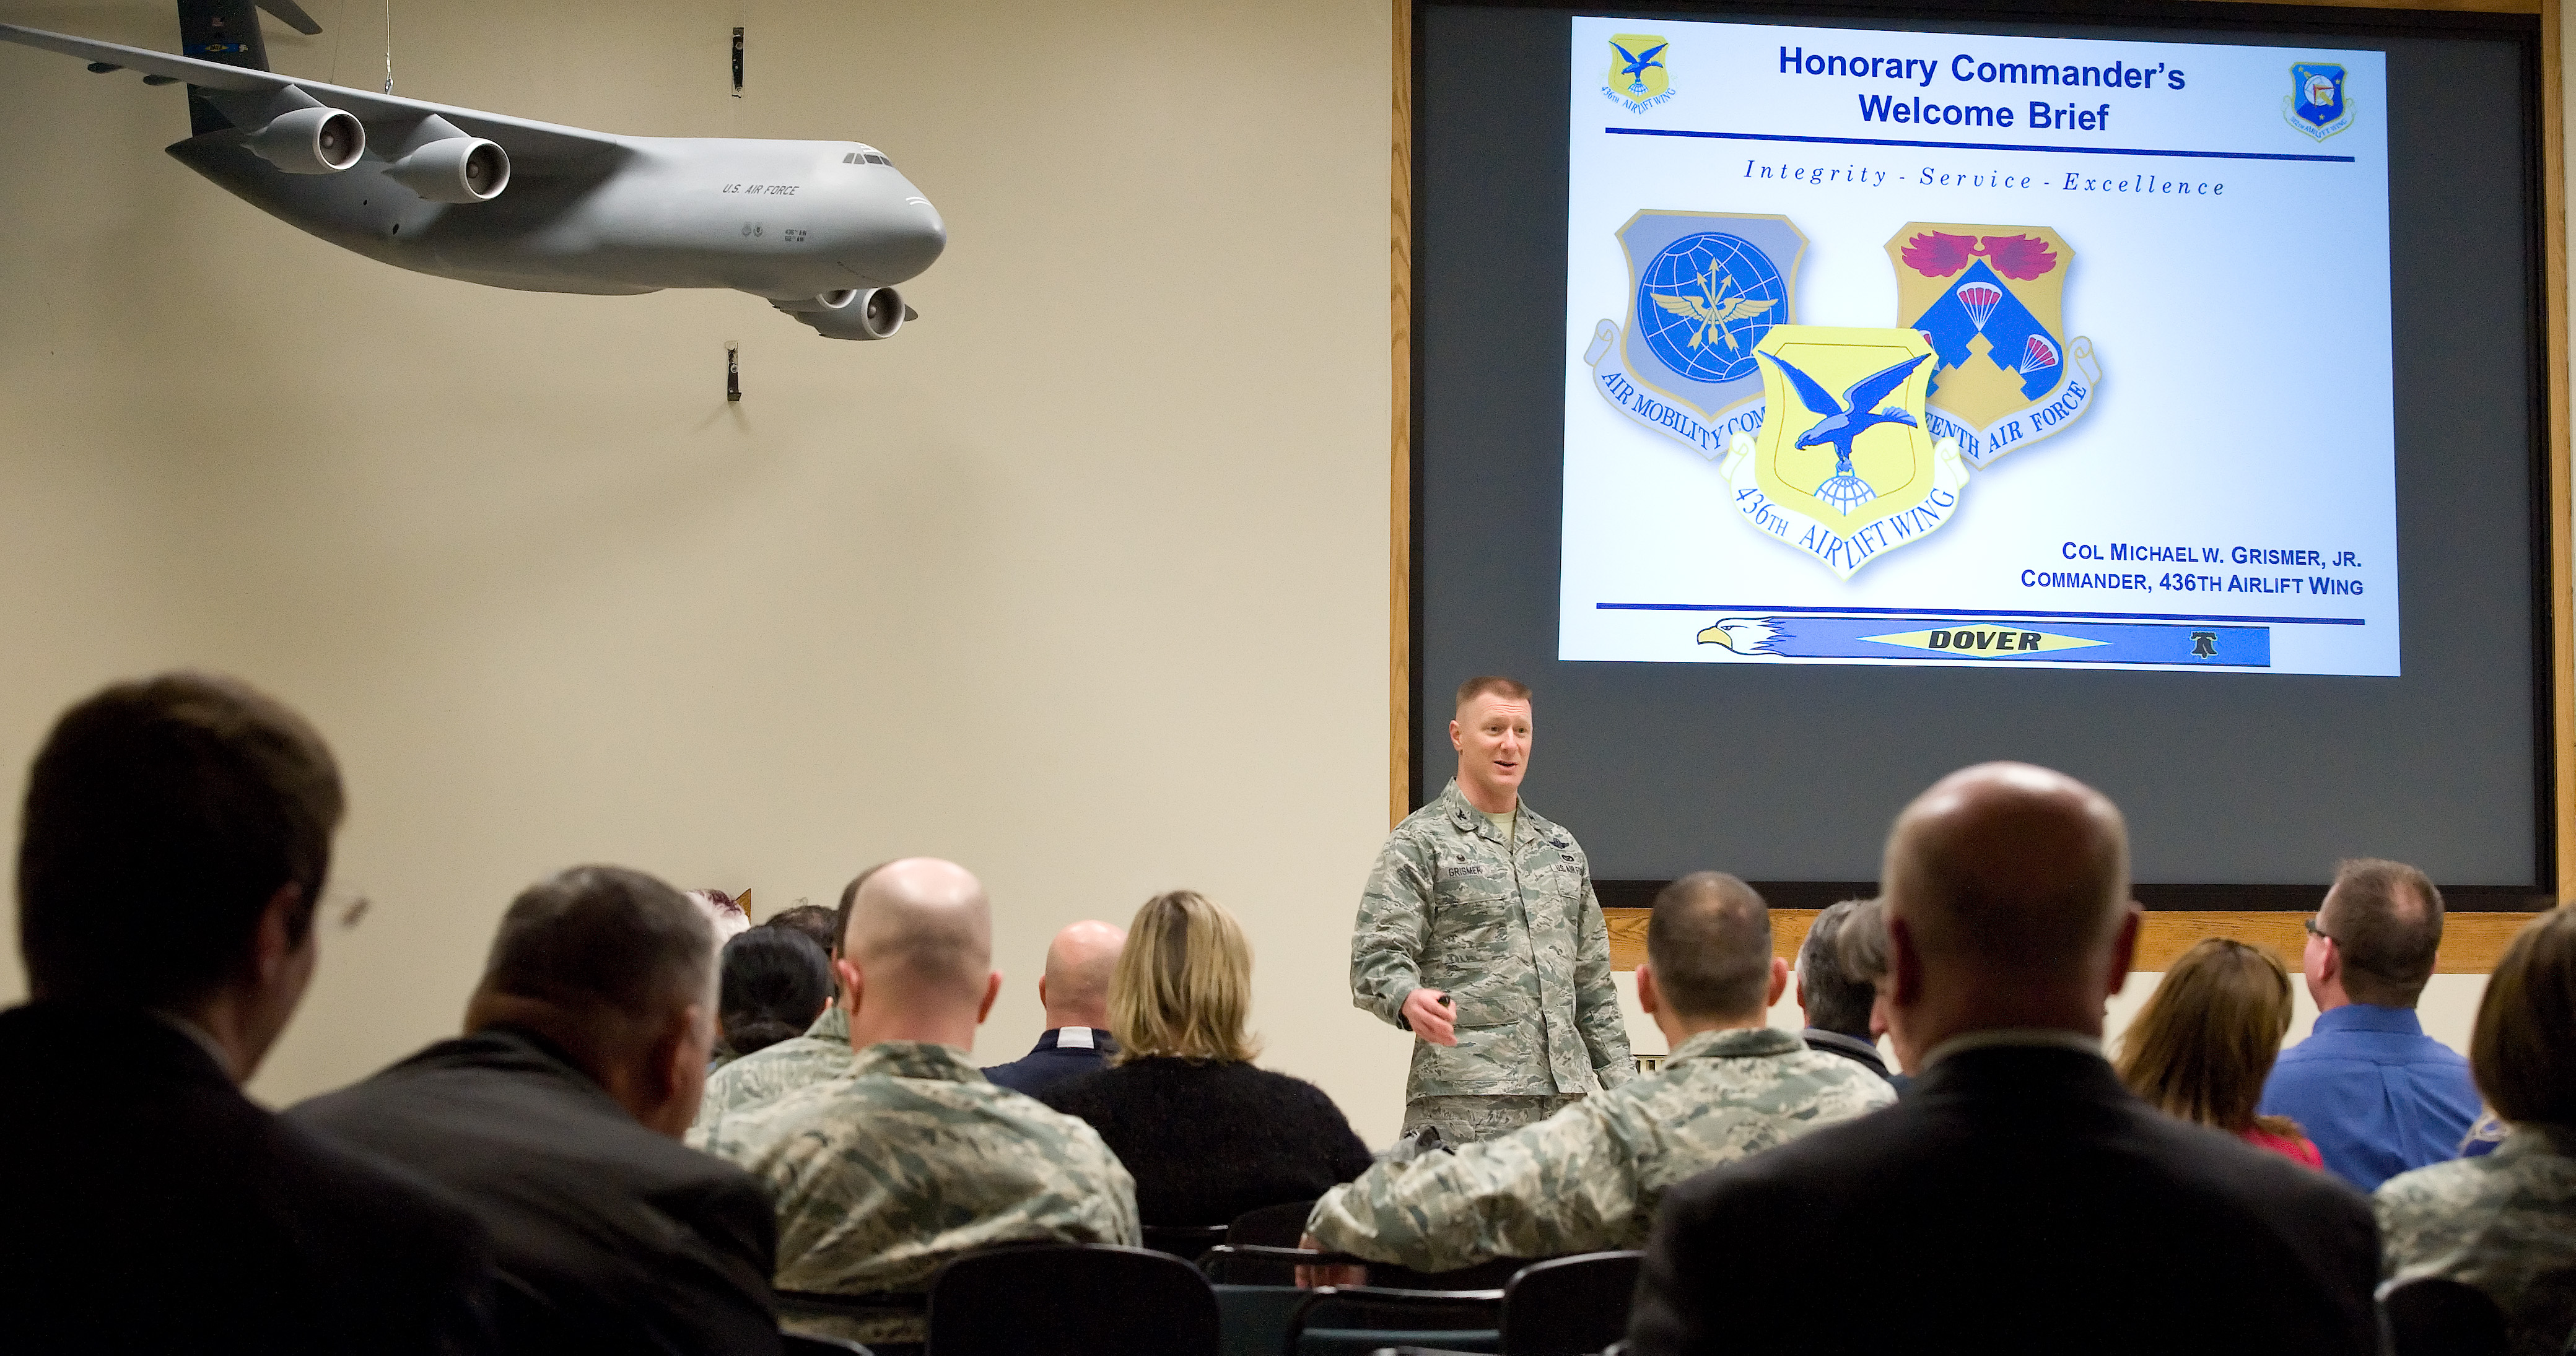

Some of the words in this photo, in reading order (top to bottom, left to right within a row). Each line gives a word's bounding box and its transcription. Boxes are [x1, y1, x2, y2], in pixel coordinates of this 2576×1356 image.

[1779, 46, 1937, 87] Honorary
[1952, 54, 2186, 90] Commander’s
[1601, 86, 1620, 103] 436TH
[1622, 98, 1653, 115] AIRLIFT
[1653, 87, 1676, 105] WING
[1858, 94, 2015, 128] Welcome
[2028, 101, 2110, 131] Brief
[723, 184, 741, 193] U.S.
[744, 185, 764, 194] AIR
[763, 185, 800, 196] FORCE
[1744, 160, 1886, 187] Integrity
[1919, 167, 2030, 188] Service
[2063, 172, 2224, 196] Excellence
[1601, 373, 1635, 406] AIR
[1631, 393, 1724, 450] MOBILITY
[1989, 420, 2023, 454] AIR
[2029, 380, 2087, 432] FORCE
[1736, 488, 1789, 537] 436TH
[1799, 521, 1887, 571] AIRLIFT
[1888, 488, 1954, 540] WING
[2203, 547, 2224, 563] W.
[2333, 551, 2362, 567] JR.
[2159, 573, 2222, 592] 436TH
[1928, 630, 2042, 651] DOVER
[1449, 866, 1482, 877] GRISMER
